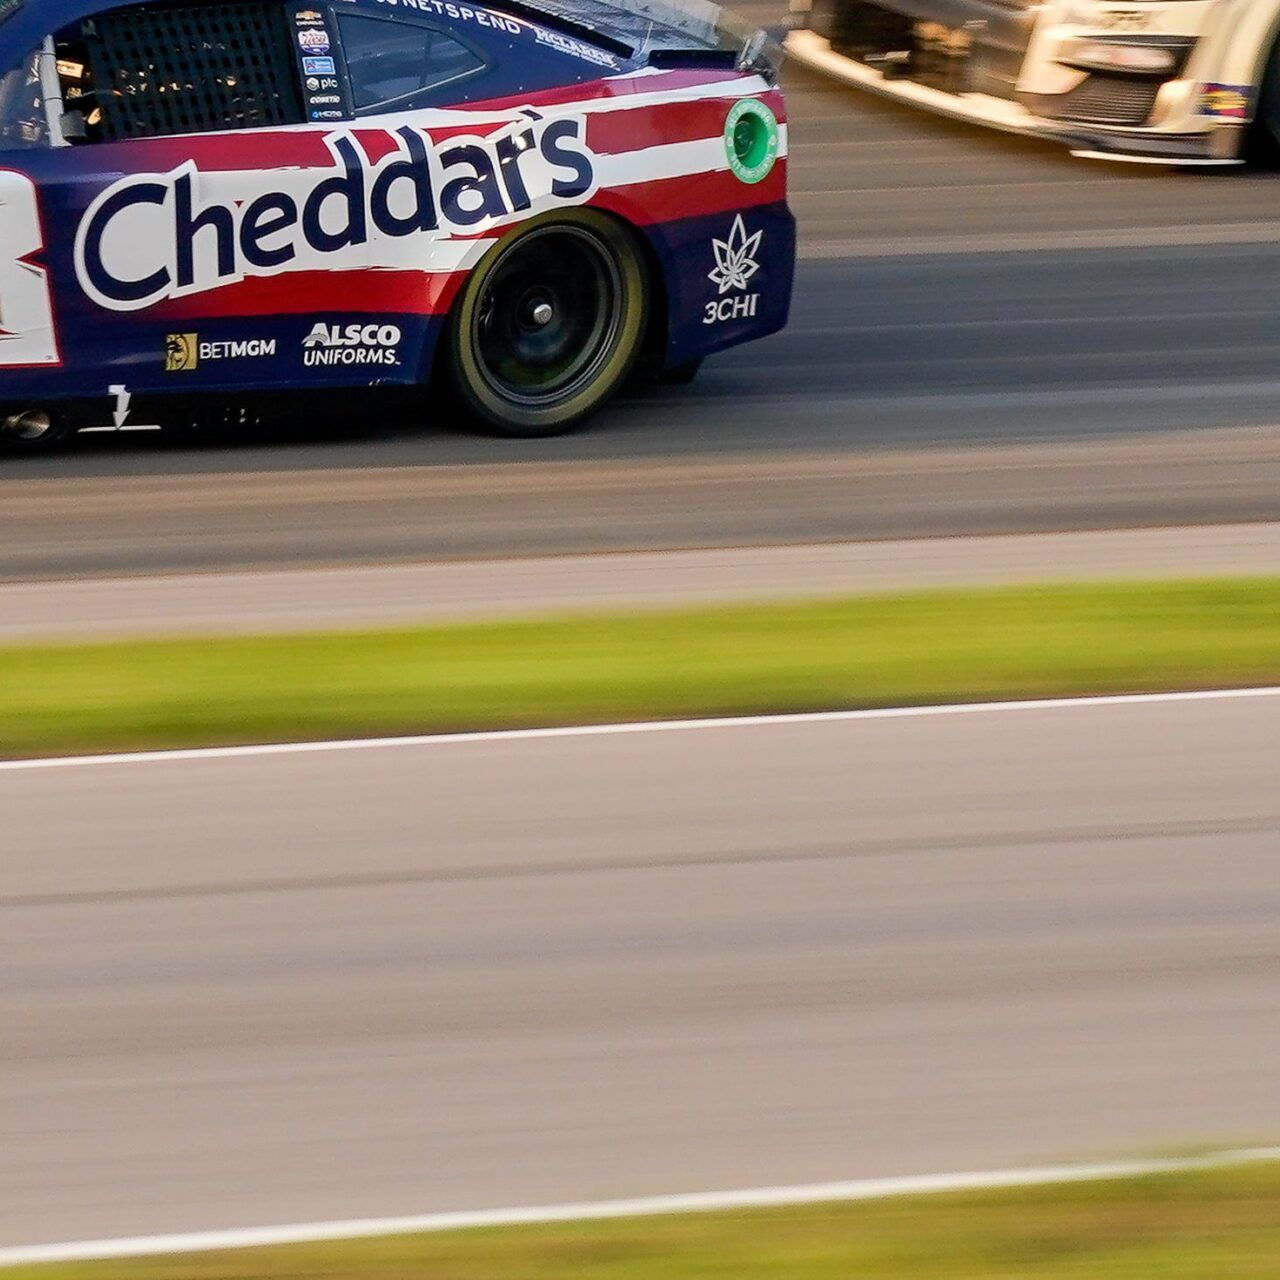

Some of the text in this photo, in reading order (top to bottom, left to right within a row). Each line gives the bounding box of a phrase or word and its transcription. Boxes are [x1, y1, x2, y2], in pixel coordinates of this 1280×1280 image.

[82, 109, 593, 302] Cheddar's
[702, 293, 759, 324] 3CHI
[302, 322, 401, 348] ALSCO
[199, 339, 277, 360] BETMGM
[303, 347, 396, 366] UNIFORMS
